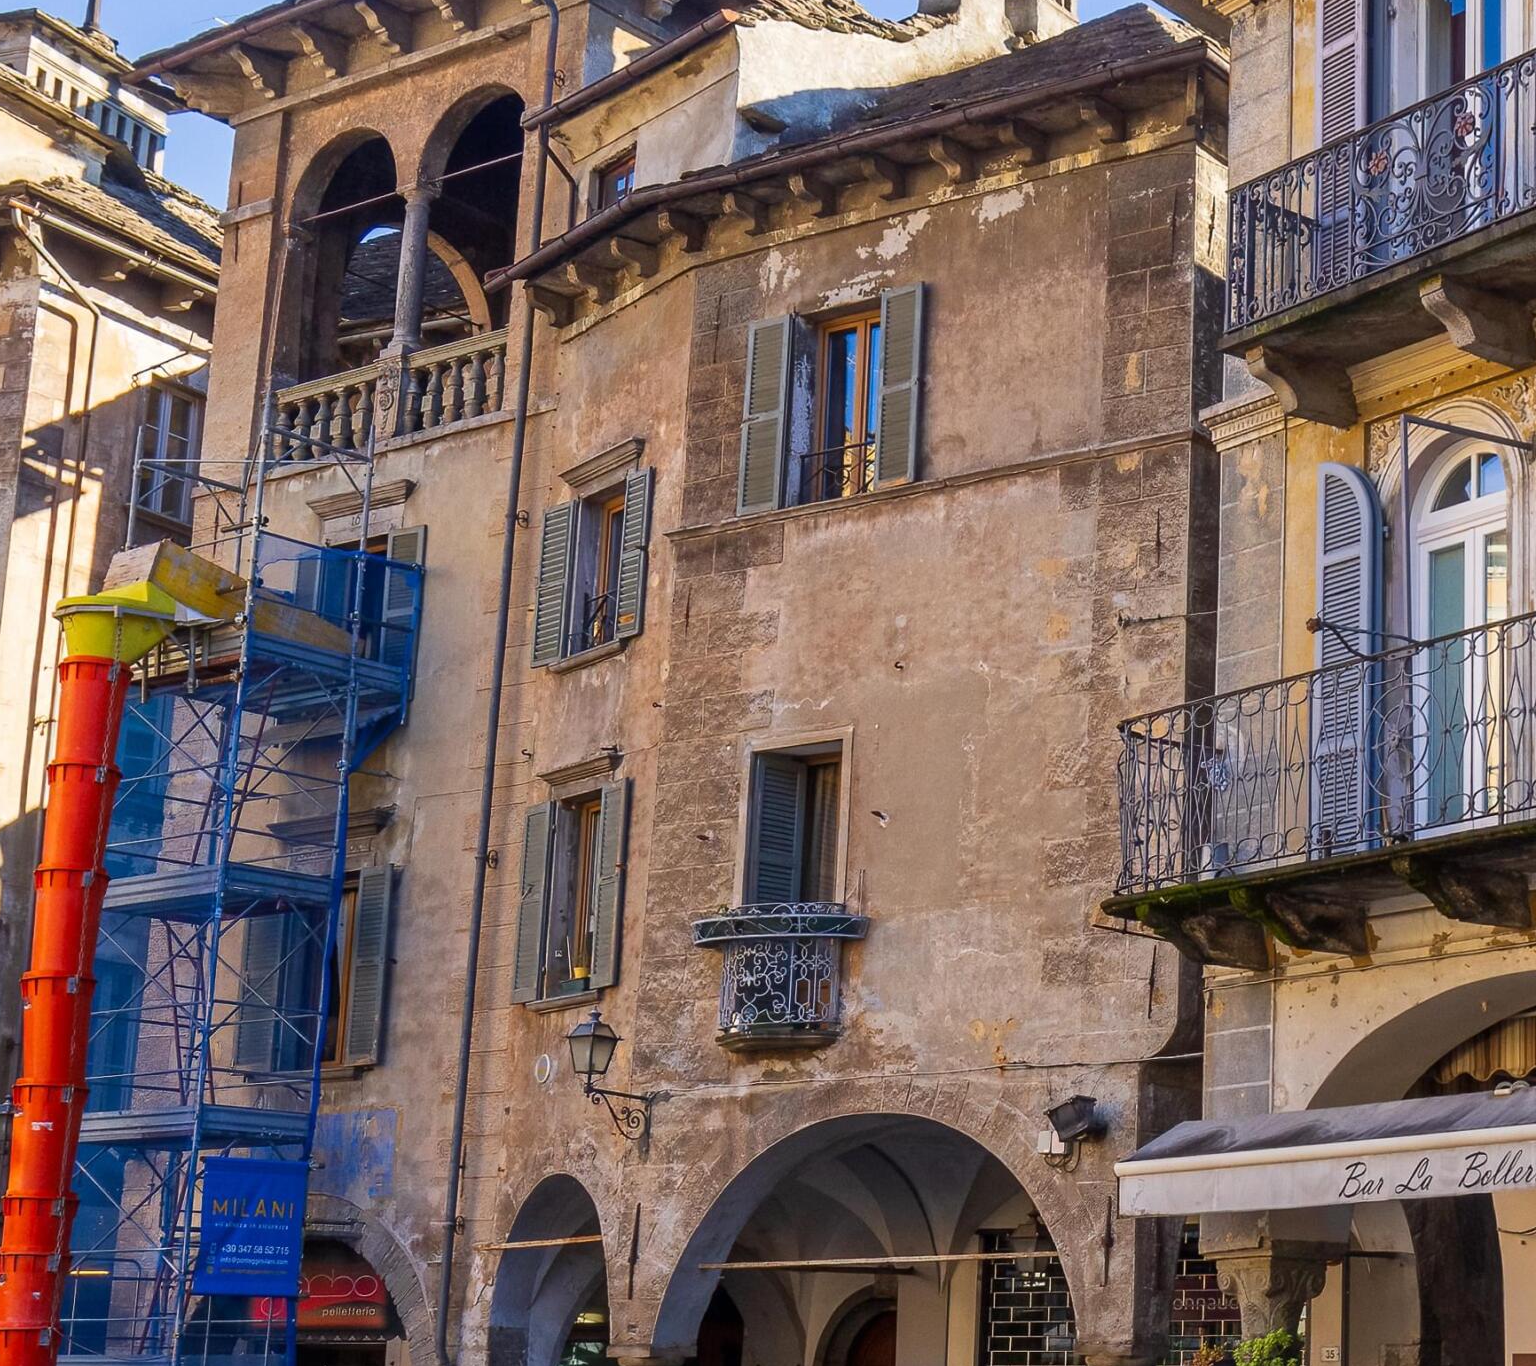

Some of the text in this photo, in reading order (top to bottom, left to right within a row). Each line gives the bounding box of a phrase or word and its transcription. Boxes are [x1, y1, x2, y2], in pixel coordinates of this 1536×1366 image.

[1338, 1160, 1384, 1198] Bar
[1395, 1156, 1433, 1195] La
[212, 1199, 294, 1219] MILANI
[222, 1244, 236, 1253] +39
[238, 1245, 252, 1254] 347
[264, 1246, 274, 1255] 52
[275, 1246, 289, 1255] 715
[322, 1306, 376, 1318] pelletteria
[1325, 1348, 1336, 1360] 35
